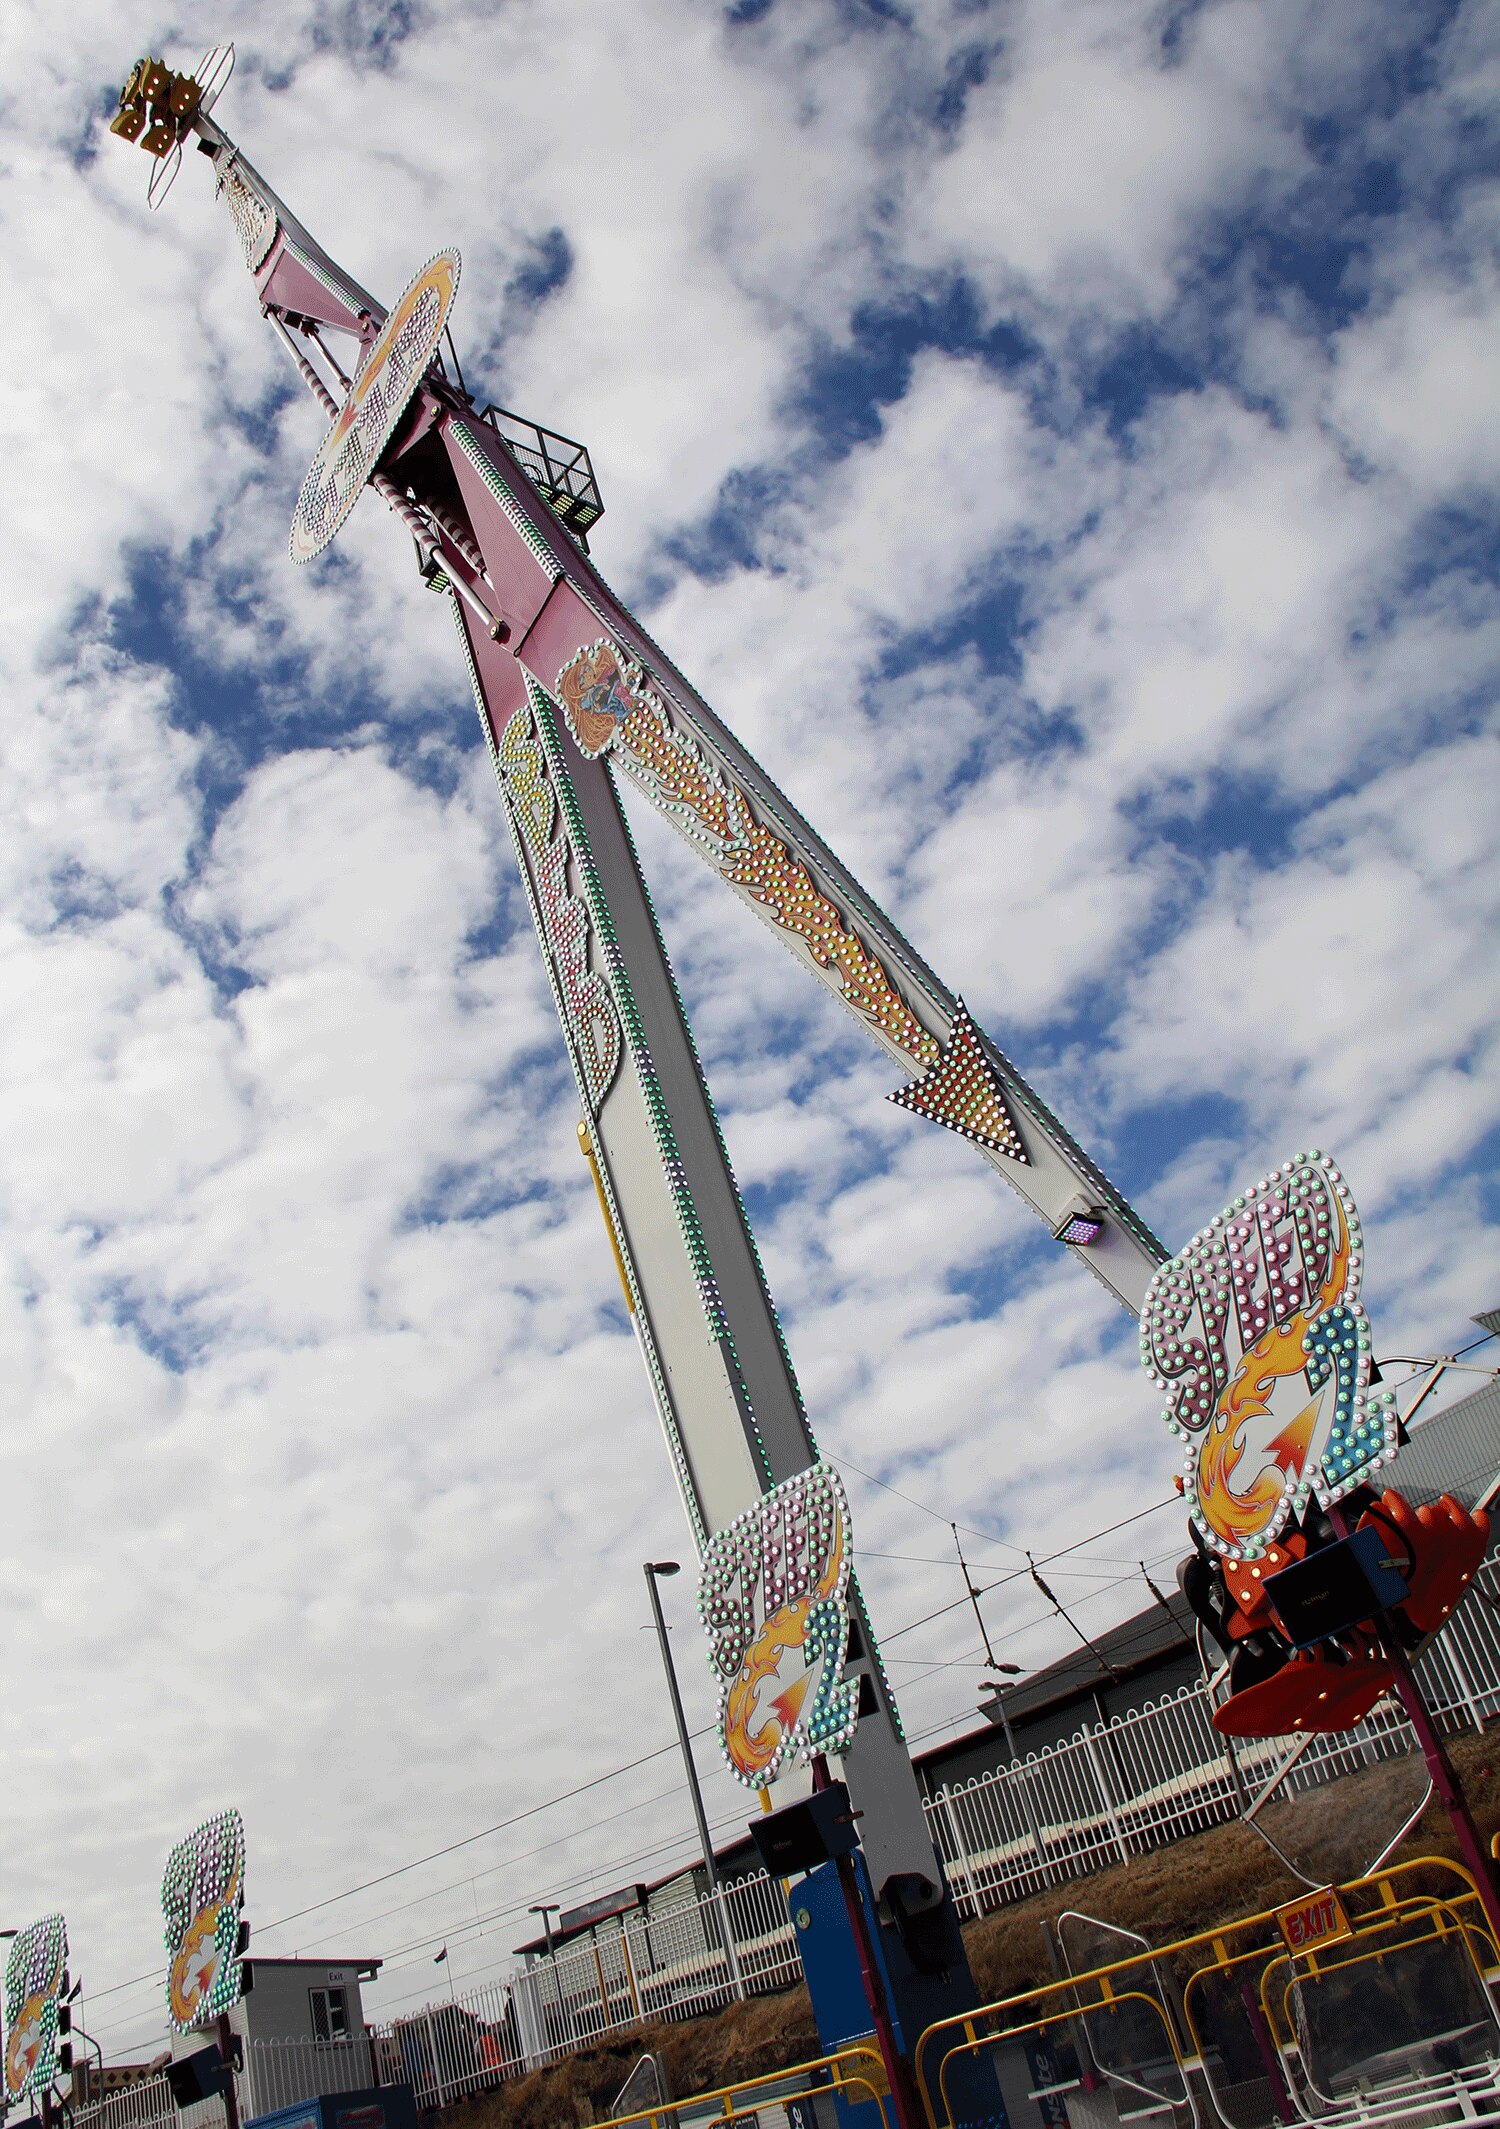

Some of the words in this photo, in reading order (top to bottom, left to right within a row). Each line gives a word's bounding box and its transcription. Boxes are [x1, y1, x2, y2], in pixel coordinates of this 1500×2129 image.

[313, 287, 441, 543] SPEED
[501, 708, 619, 1105] SPEED
[1151, 1166, 1330, 1431] SPEED
[1304, 1305, 1385, 1489] 2
[706, 1475, 834, 1678] SPEED
[803, 1599, 850, 1746] 2
[165, 1818, 236, 1951] SPEED
[1285, 1897, 1336, 1947] EXIT
[8, 1921, 61, 2025] SPEED
[329, 1972, 343, 1981] Exit
